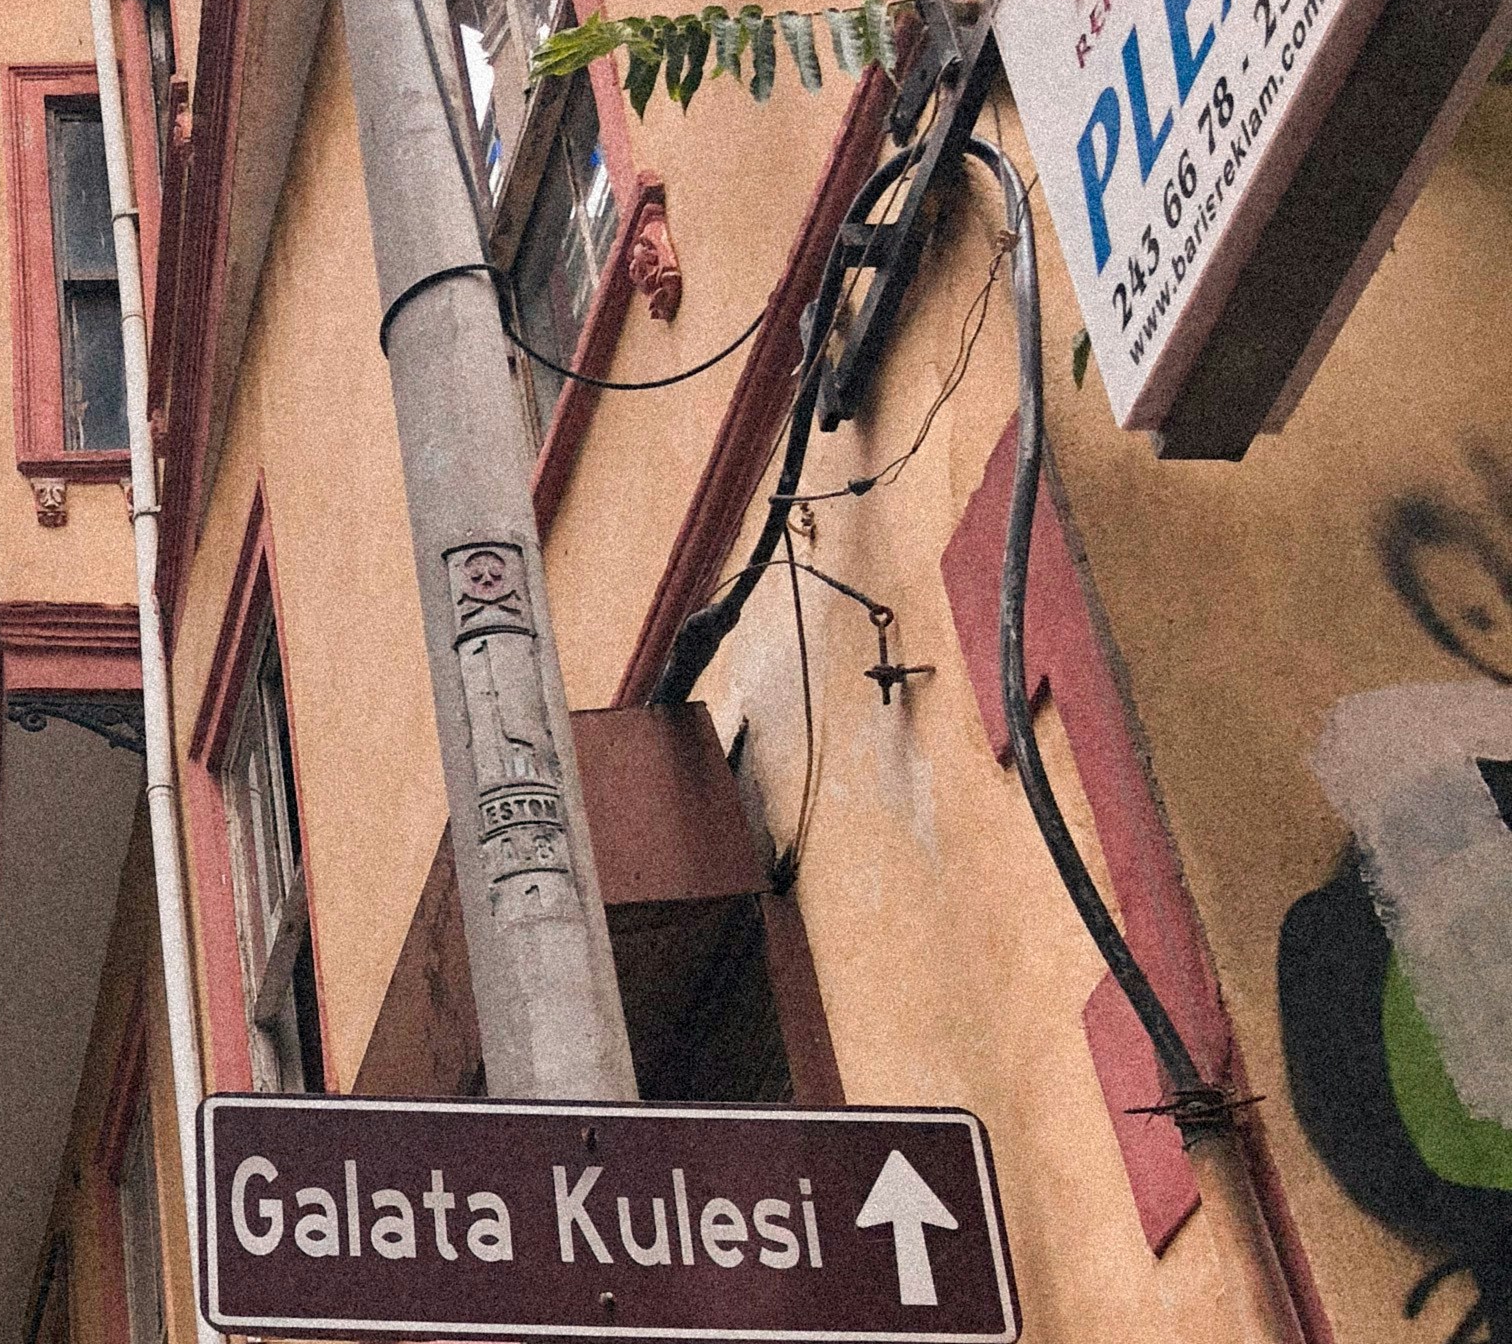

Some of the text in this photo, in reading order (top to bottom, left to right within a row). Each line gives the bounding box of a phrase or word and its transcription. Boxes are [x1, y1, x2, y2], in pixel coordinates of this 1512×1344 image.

[1112, 223, 1161, 332] 243
[1163, 149, 1198, 230] 66
[1198, 76, 1236, 154] 78
[230, 1154, 824, 1270] Galata Kulesi
